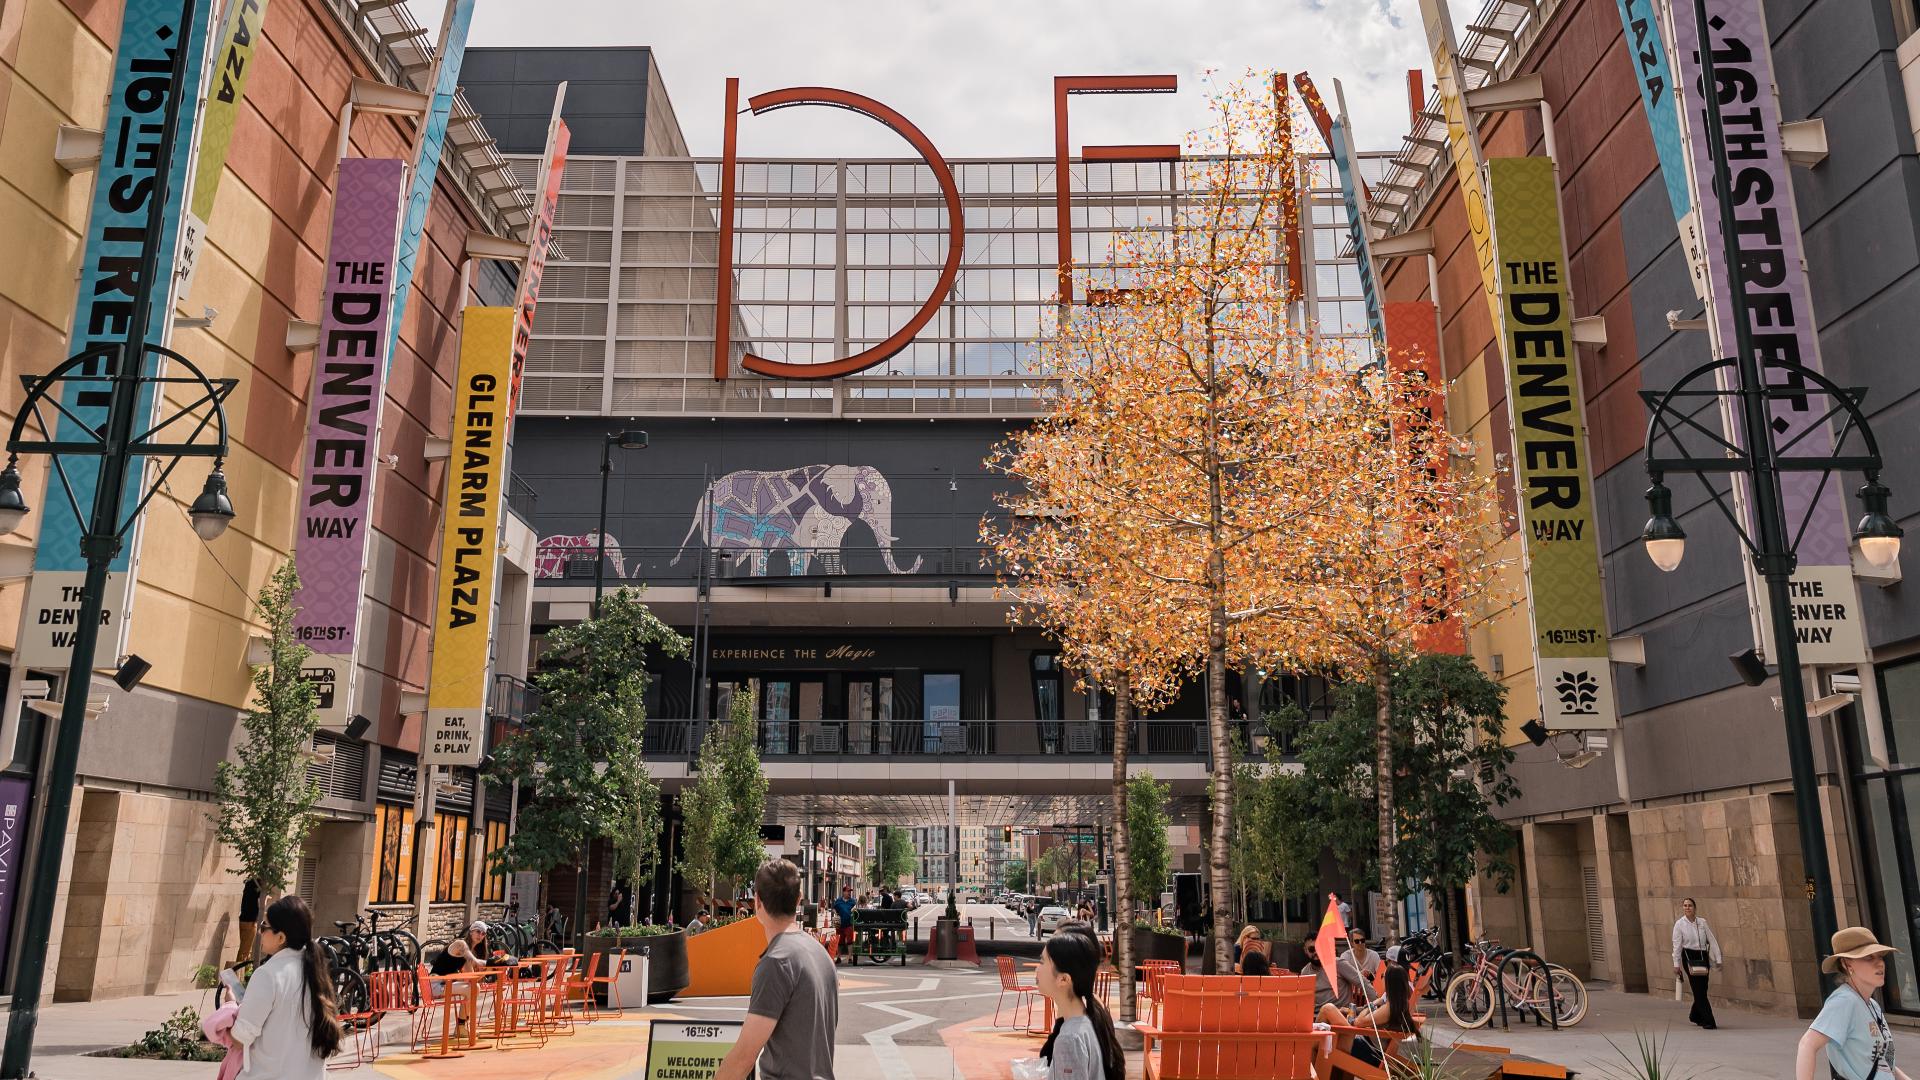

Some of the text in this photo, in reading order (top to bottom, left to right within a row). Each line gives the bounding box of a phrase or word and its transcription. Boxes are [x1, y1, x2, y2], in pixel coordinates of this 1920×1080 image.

[335, 262, 385, 284] THE
[1506, 261, 1558, 285] THE
[309, 292, 382, 508] DENVER
[1509, 292, 1581, 510] DENVER
[449, 373, 497, 629] GLENARM PLAZA
[306, 517, 358, 539] WAY
[1532, 519, 1584, 541] WAY
[61, 586, 85, 602] TH
[1789, 581, 1824, 597] THE
[38, 608, 112, 626] DENR
[51, 631, 76, 648] WA
[712, 644, 877, 661] EXPERIENCE THE Magic
[444, 717, 466, 729] EAT,
[436, 730, 472, 742] DRINK,
[433, 743, 471, 754] & PLAY
[667, 1056, 716, 1068] WELCOME
[656, 1068, 704, 1080] GLENARM
